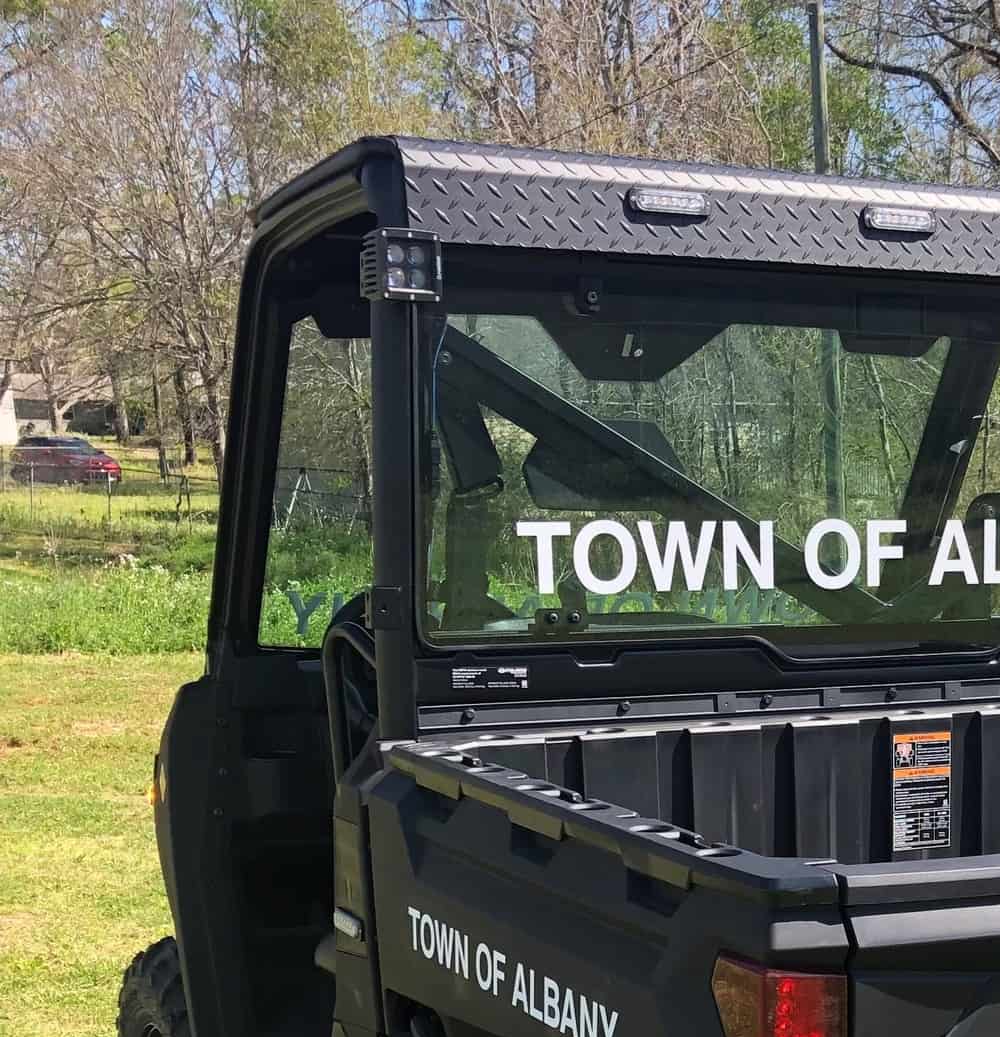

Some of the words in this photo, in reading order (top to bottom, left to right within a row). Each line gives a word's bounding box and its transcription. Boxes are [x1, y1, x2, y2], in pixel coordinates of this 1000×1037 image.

[516, 519, 774, 595] TOWN
[805, 517, 908, 590] OF
[407, 906, 469, 980] TOWN
[475, 942, 507, 997] OF
